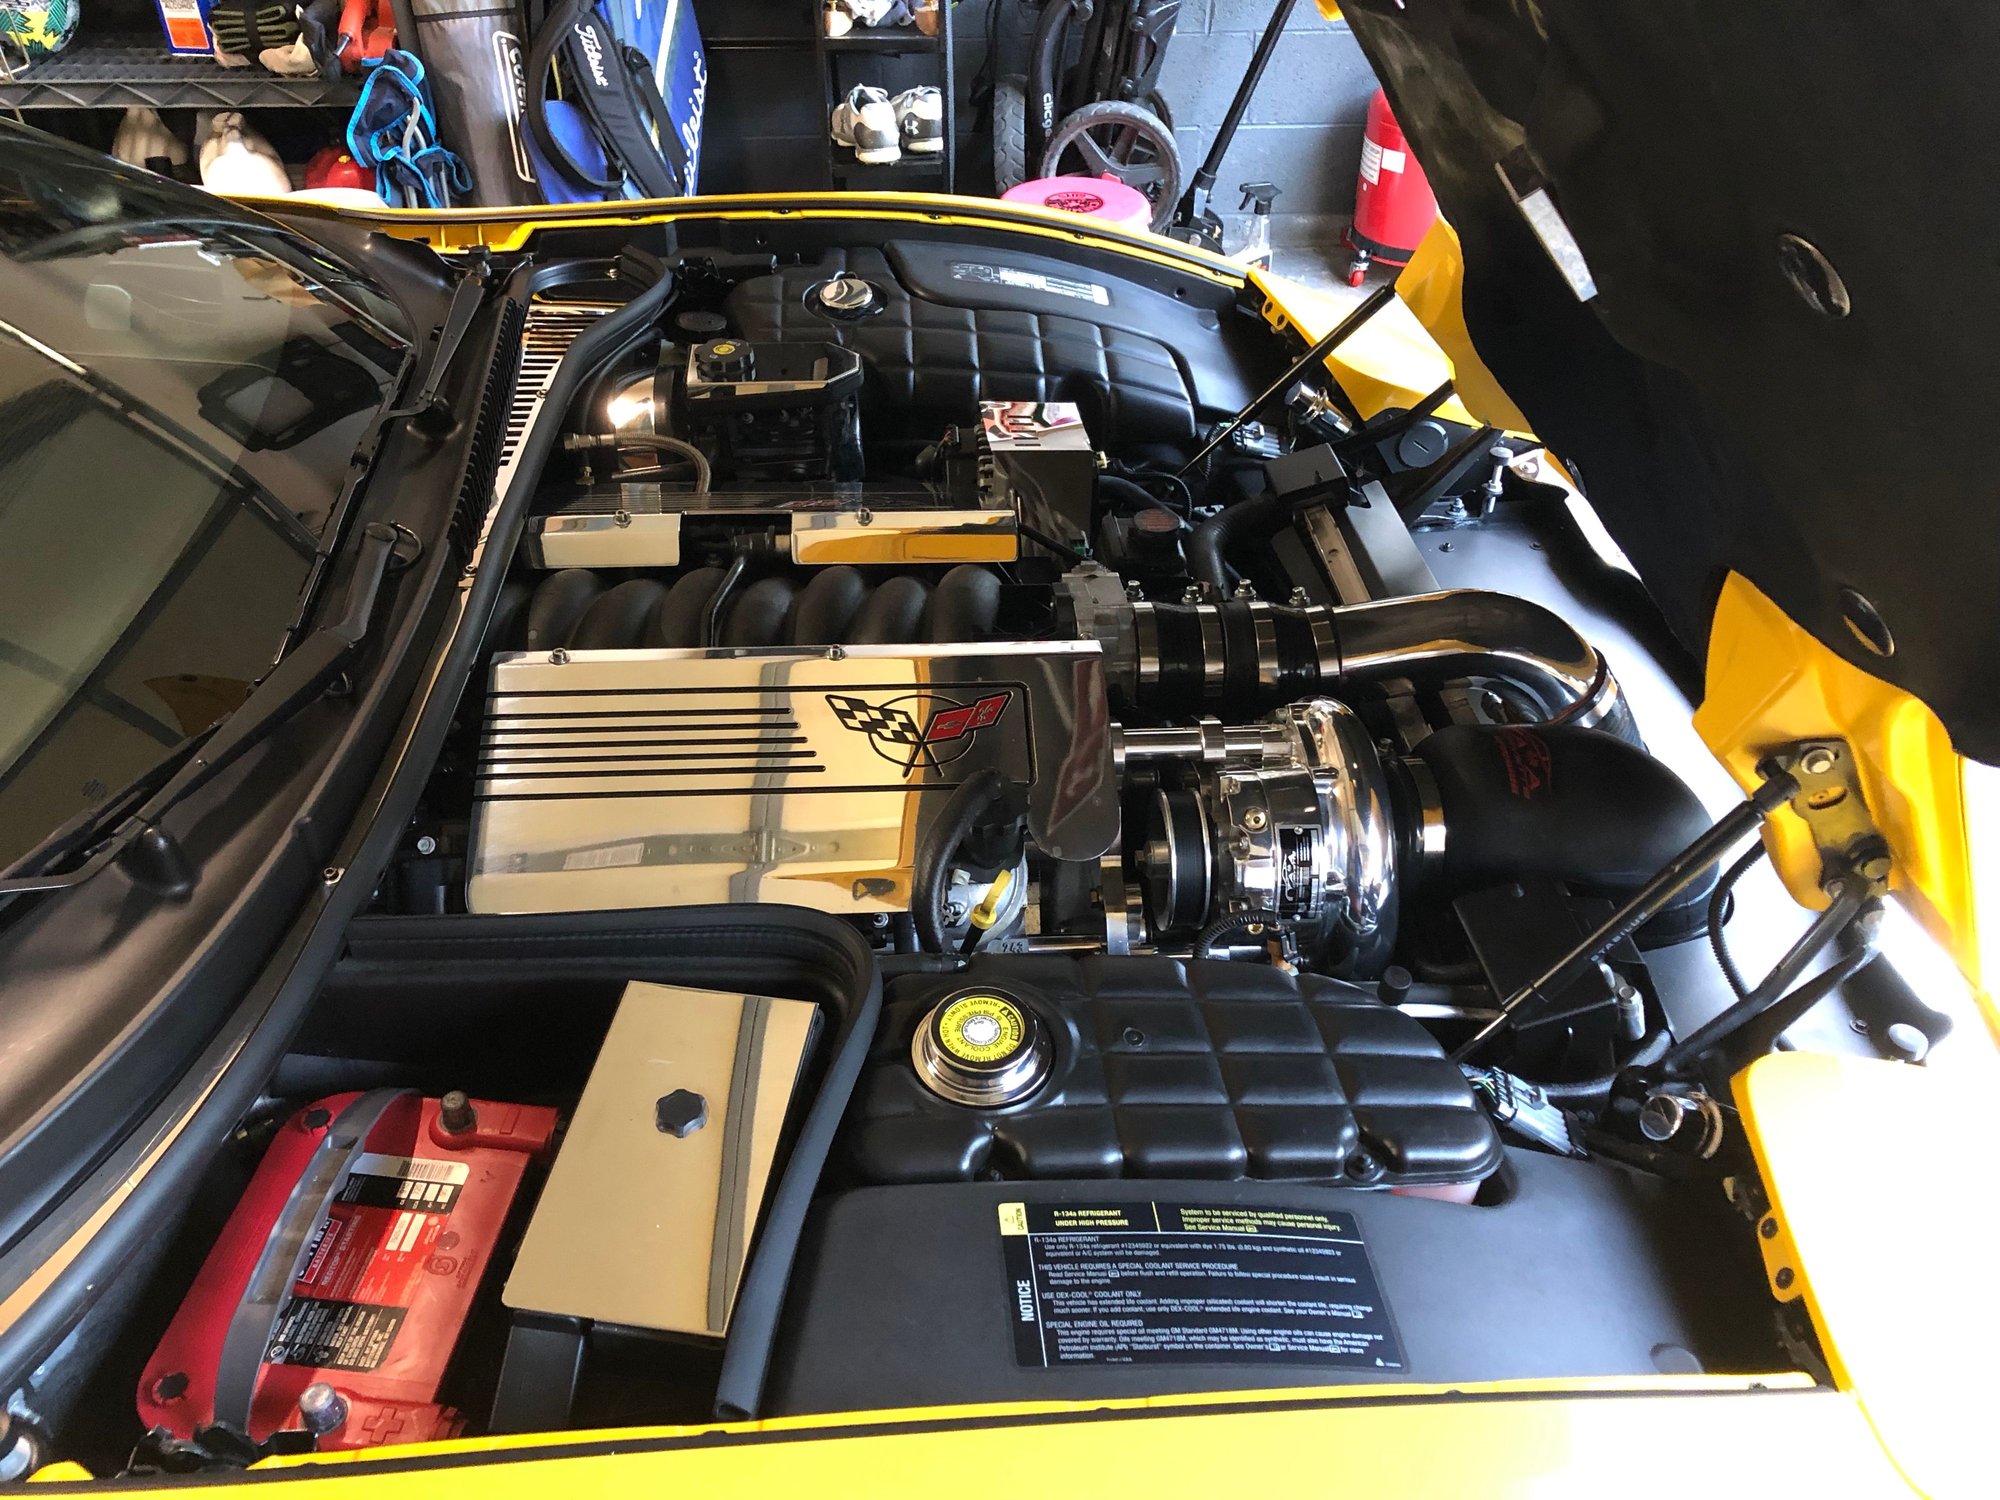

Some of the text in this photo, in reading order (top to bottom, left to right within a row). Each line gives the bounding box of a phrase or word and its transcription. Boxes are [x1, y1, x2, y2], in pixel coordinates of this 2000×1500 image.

[574, 23, 608, 87] Titleist
[681, 58, 708, 197] itleist
[1590, 911, 1648, 962] STABILUS
[948, 1003, 968, 1021] SLOWLY
[954, 1010, 982, 1032] PRESSURE
[1007, 1013, 1020, 1041] CAUTION
[945, 1037, 960, 1053] WHEN
[956, 1026, 1009, 1052] ENGINE COOLANT
[1005, 1043, 1015, 1052] DO
[961, 1052, 991, 1062] REMOVE
[993, 1051, 1007, 1060] NOT
[1016, 1208, 1024, 1231] CAUTION
[1182, 1216, 1210, 1224] Improper
[1296, 1222, 1322, 1230] personal
[1258, 1212, 1284, 1220] qualified
[1284, 1213, 1314, 1222] personnel
[312, 1231, 335, 1269] BATTERIES
[1017, 1280, 1035, 1322] NOTICE
[1074, 1320, 1097, 1328] ENGINE
